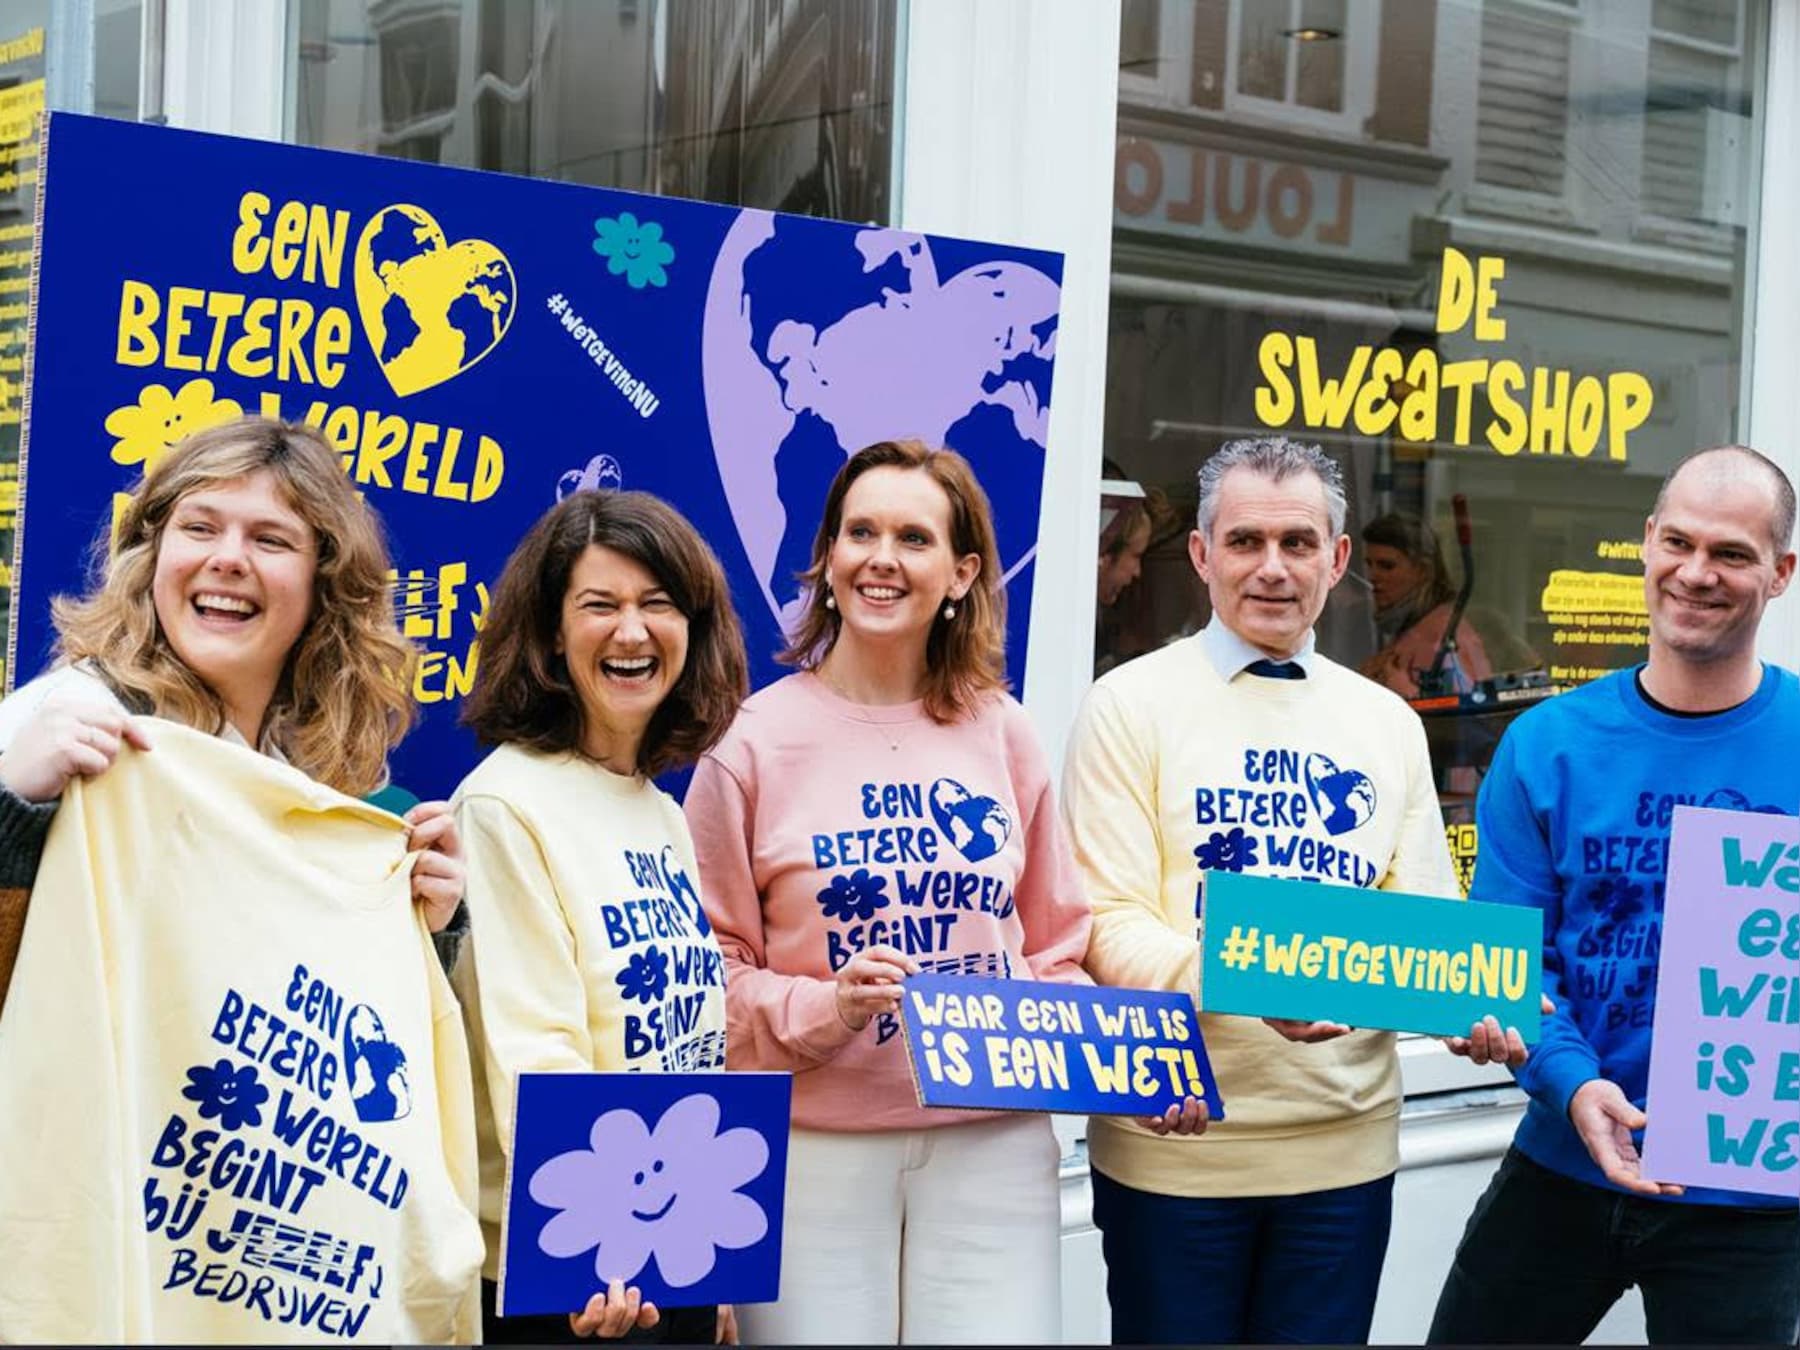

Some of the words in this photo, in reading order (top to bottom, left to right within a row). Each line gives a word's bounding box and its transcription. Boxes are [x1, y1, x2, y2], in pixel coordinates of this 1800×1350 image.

[1436, 247, 1507, 341] DE
[260, 392, 505, 503] eRELD
[1583, 836, 1670, 875] BETE
[1081, 1042, 1205, 1098] WET!
[1707, 1113, 1799, 1174] WE
